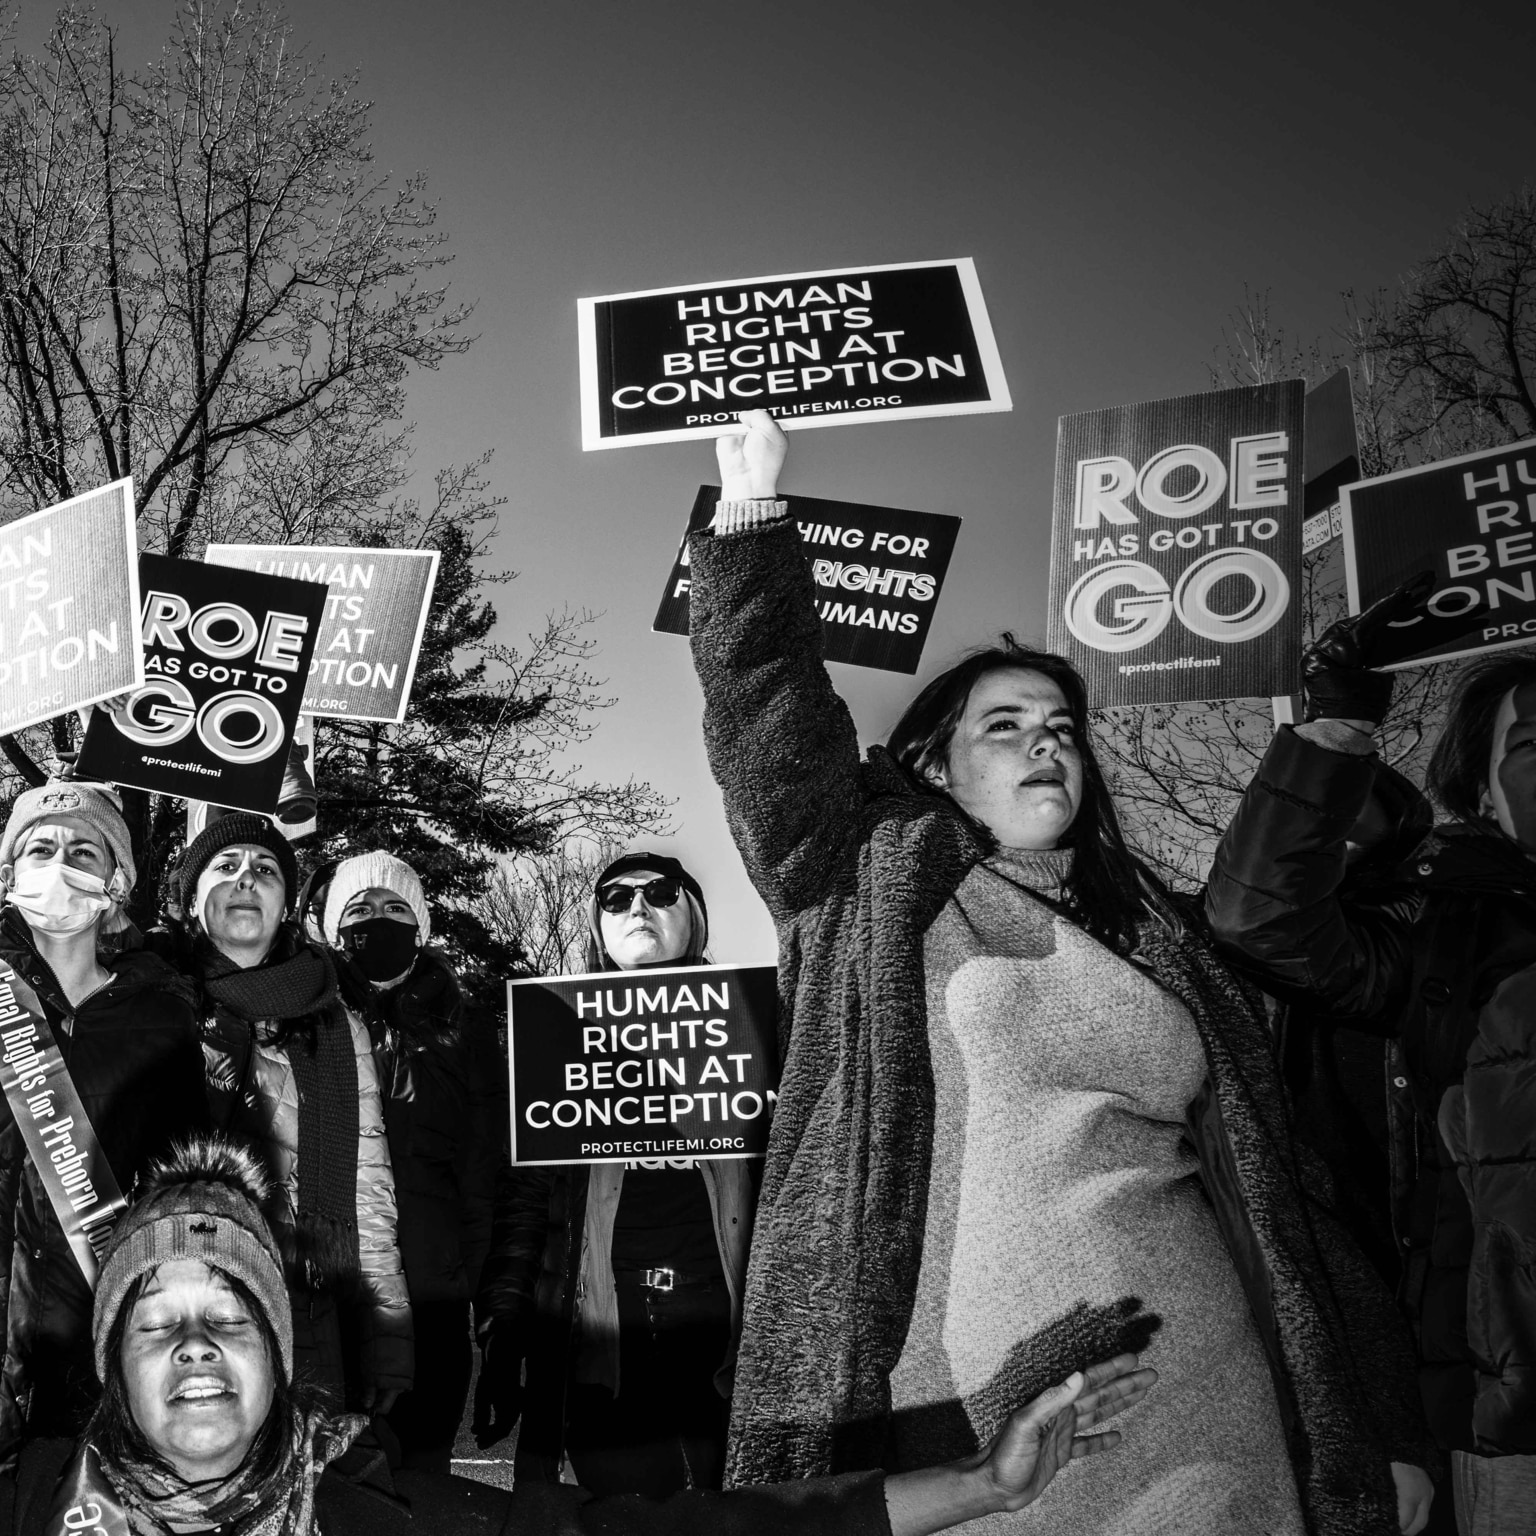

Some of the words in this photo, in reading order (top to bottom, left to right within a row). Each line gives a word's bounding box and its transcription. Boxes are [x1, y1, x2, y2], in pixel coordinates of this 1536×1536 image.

[677, 280, 873, 321] HUMAN
[685, 306, 874, 346] RIGHTS
[663, 338, 821, 377] BEGIN
[838, 330, 905, 359] AT
[611, 353, 966, 410] CONCEPTION
[685, 394, 903, 426] PROTTLIFEMI.ORG
[1073, 431, 1289, 530] ROE
[871, 532, 930, 558] FOR
[1073, 532, 1140, 562] HAS
[1149, 522, 1223, 553] GOT
[1230, 517, 1279, 543] TO
[813, 559, 937, 601] RIGHTS
[1064, 546, 1291, 653] GO
[18, 596, 74, 648] AT
[141, 589, 309, 673] ROE
[814, 599, 920, 635] UMANS
[327, 627, 375, 654] AT
[143, 652, 183, 676] AS
[188, 661, 249, 687] GOT
[252, 670, 288, 695] TO
[111, 674, 286, 765] GO
[576, 982, 730, 1019] HUMAN
[582, 1018, 729, 1054] RIGHTS
[1, 1022, 52, 1093] Rights
[564, 1057, 686, 1091] BEGIN
[698, 1053, 753, 1085] AT
[26, 1088, 56, 1121] for
[38, 1114, 99, 1213] Preborn
[580, 1137, 746, 1155] PROTECTLIFEMI.ORG
